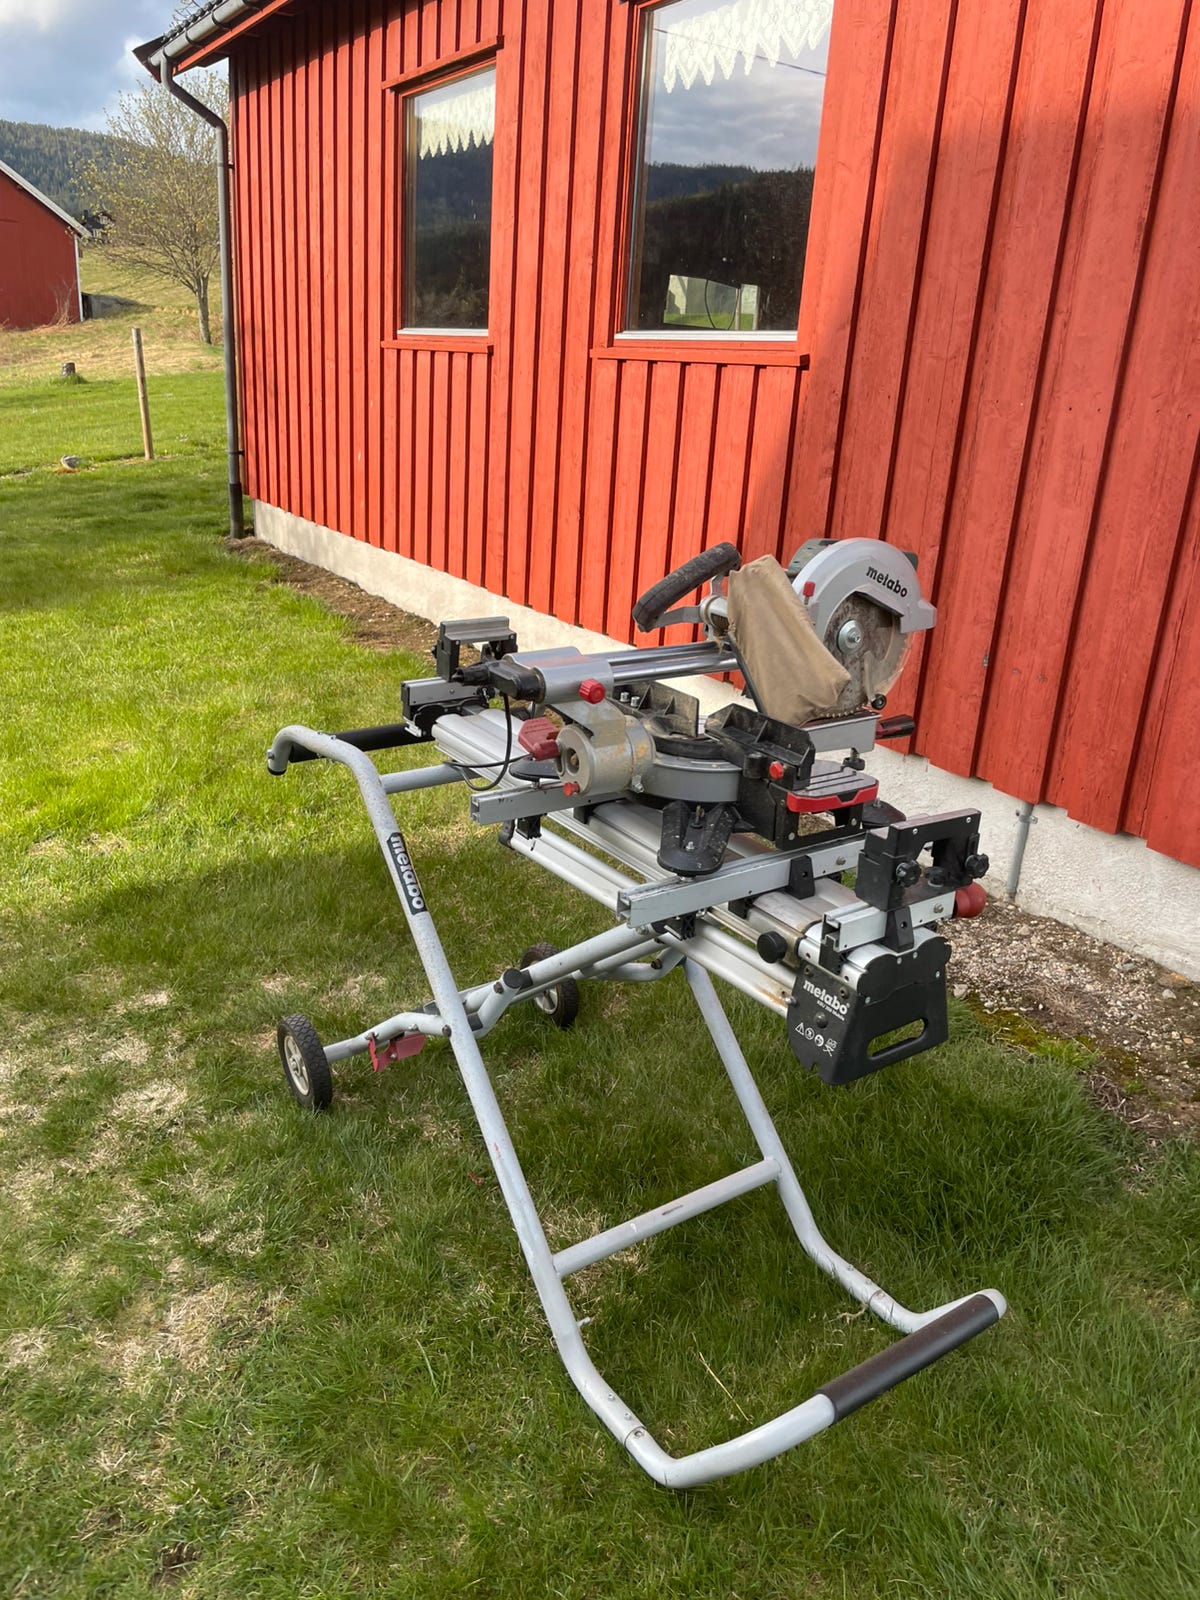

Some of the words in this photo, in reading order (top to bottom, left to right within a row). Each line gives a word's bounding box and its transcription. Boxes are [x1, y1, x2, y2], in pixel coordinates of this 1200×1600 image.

[866, 566, 908, 598] metabo
[390, 835, 425, 910] metabo
[802, 979, 848, 1015] metabo
